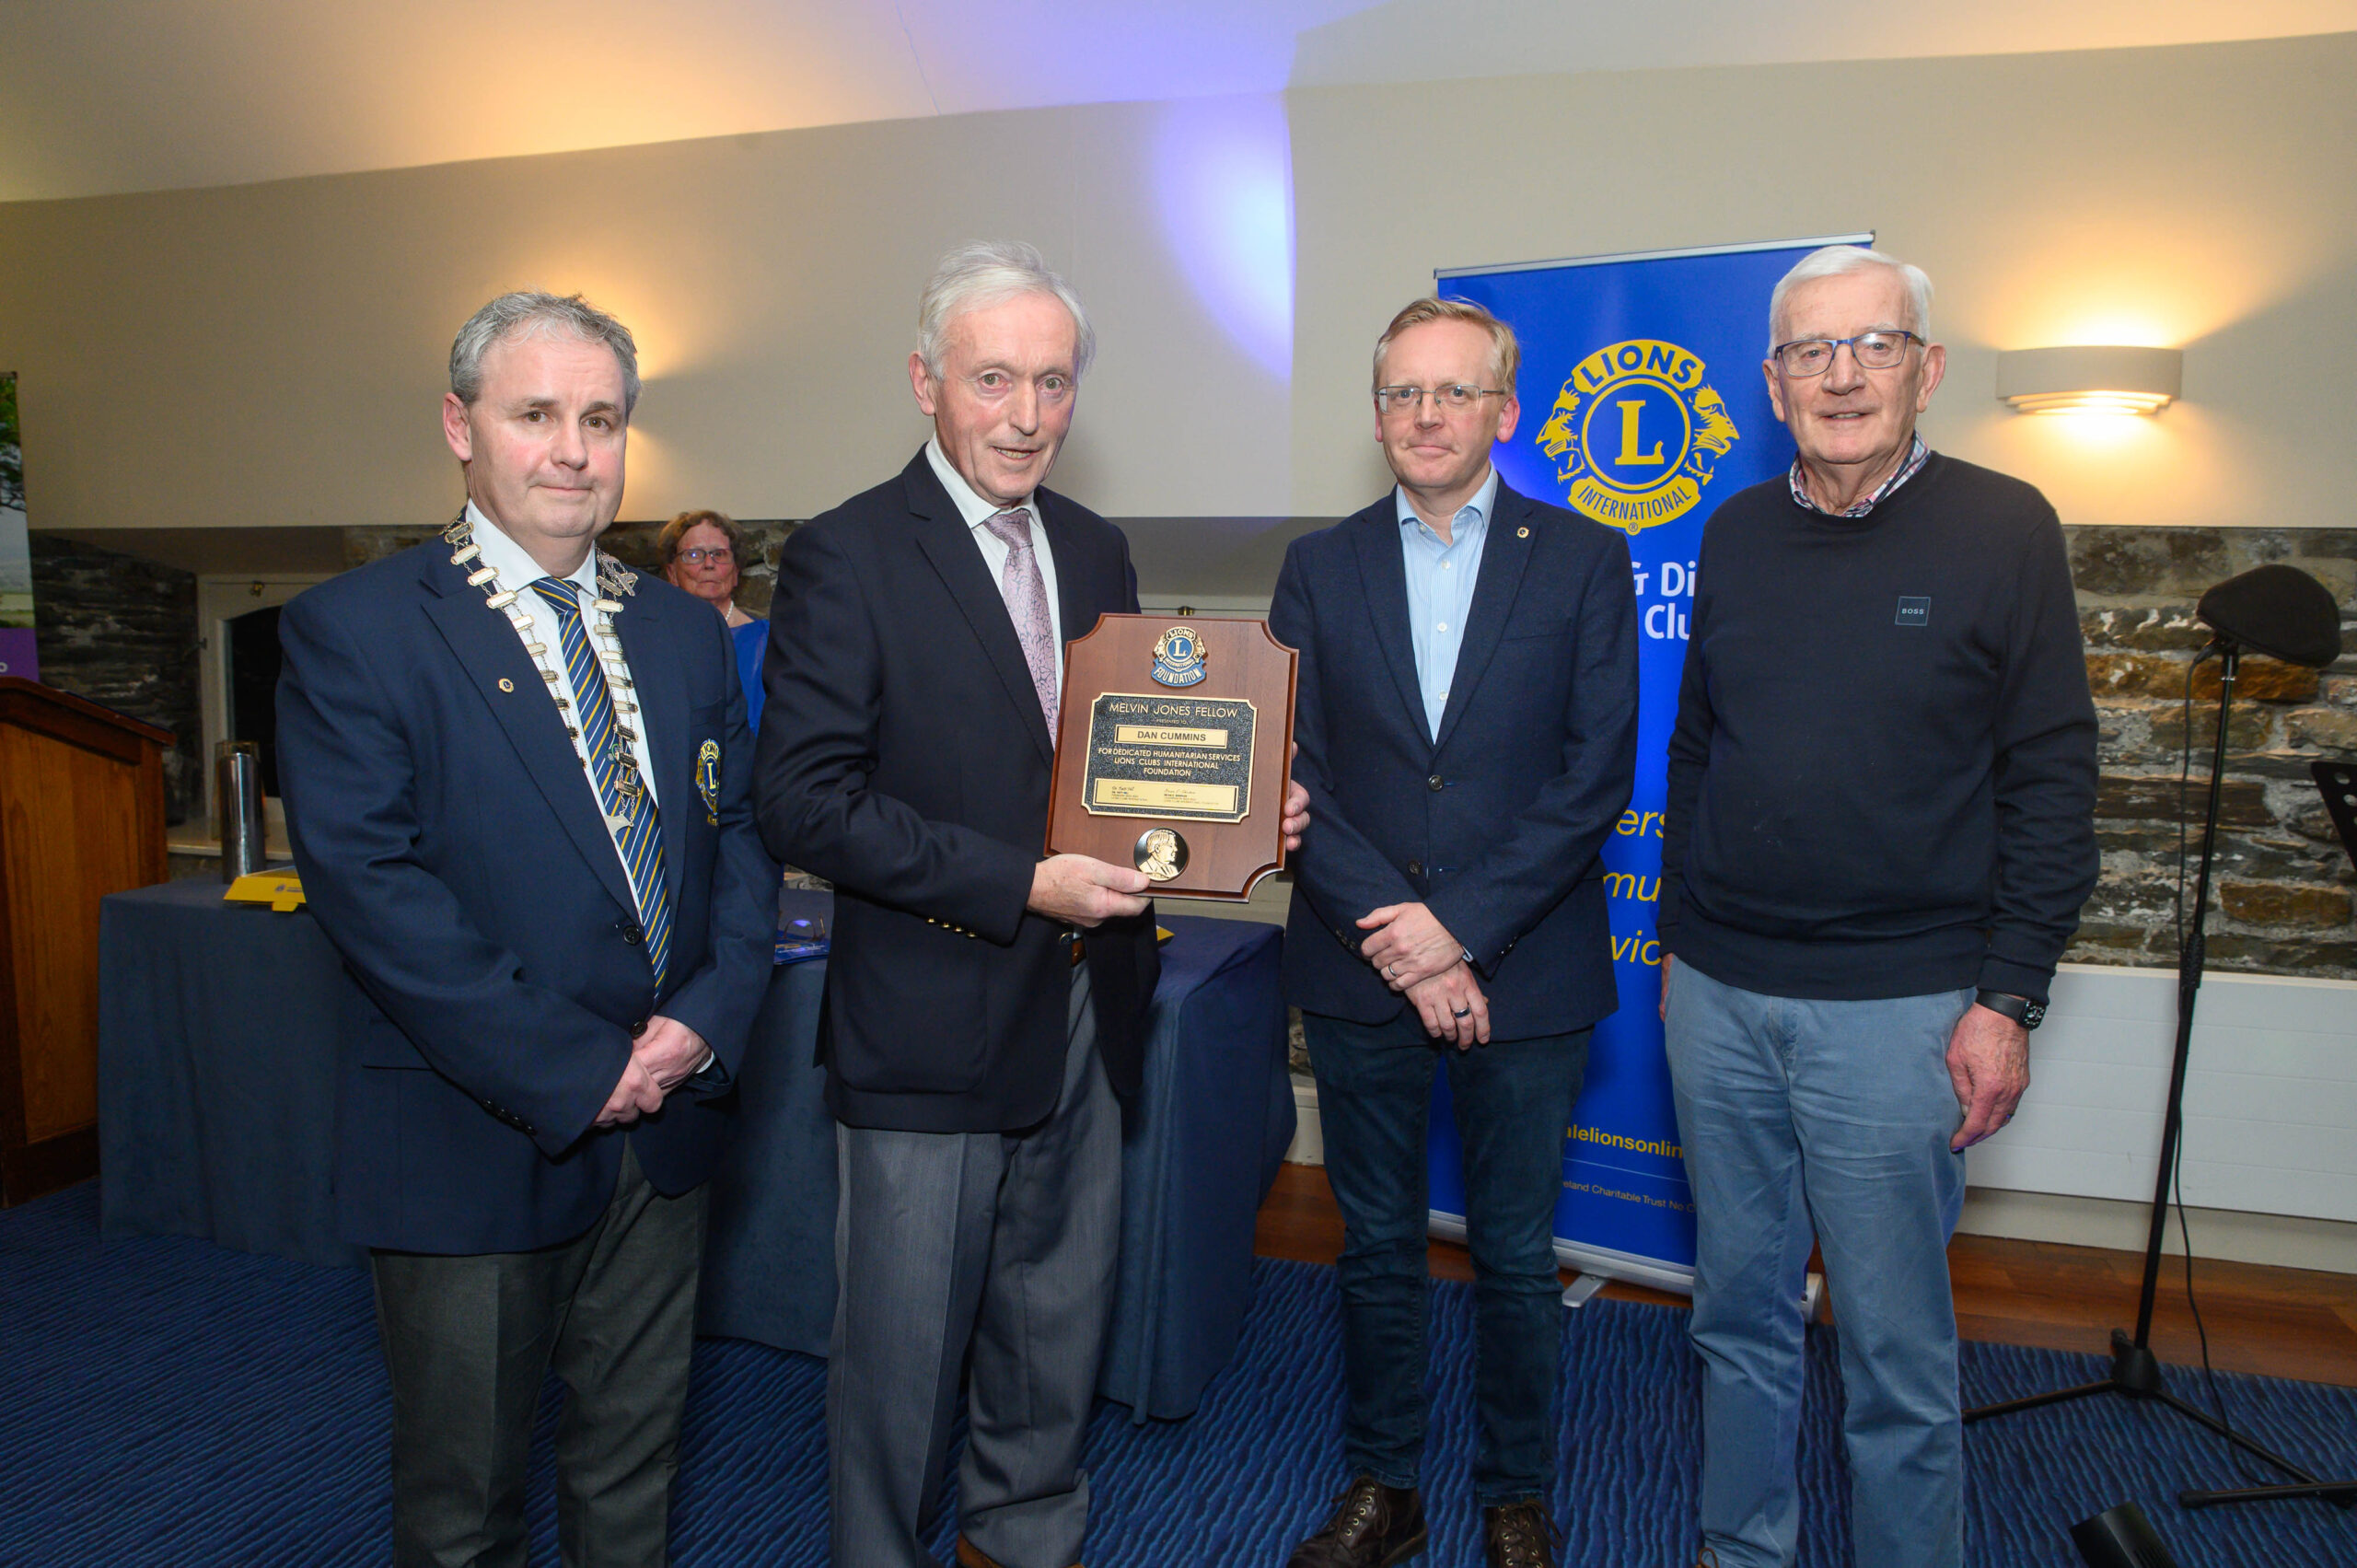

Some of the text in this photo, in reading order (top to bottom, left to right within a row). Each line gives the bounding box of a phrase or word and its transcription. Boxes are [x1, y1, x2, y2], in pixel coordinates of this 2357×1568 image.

[1580, 344, 1697, 389] LIONS
[1614, 400, 1665, 466] L
[1577, 484, 1692, 521] INTERNATIONAL
[1169, 628, 1194, 638] LIONS
[1172, 639, 1187, 657] L
[1153, 666, 1202, 684] FOUNDATION
[1109, 703, 1238, 718] MELVIN JONES FELLOW
[1137, 730, 1206, 742] DAN CUMMINS
[1097, 747, 1241, 762] FOR DEDICATED HUMANITARIAN SERVICES
[1114, 757, 1219, 770] LIONS CLUBS INTERNATIONAL
[1143, 767, 1191, 777] FOUNDATION
[1591, 1184, 1642, 1203] Charitable
[1643, 1194, 1666, 1208] Trust
[1669, 1200, 1685, 1212] No
